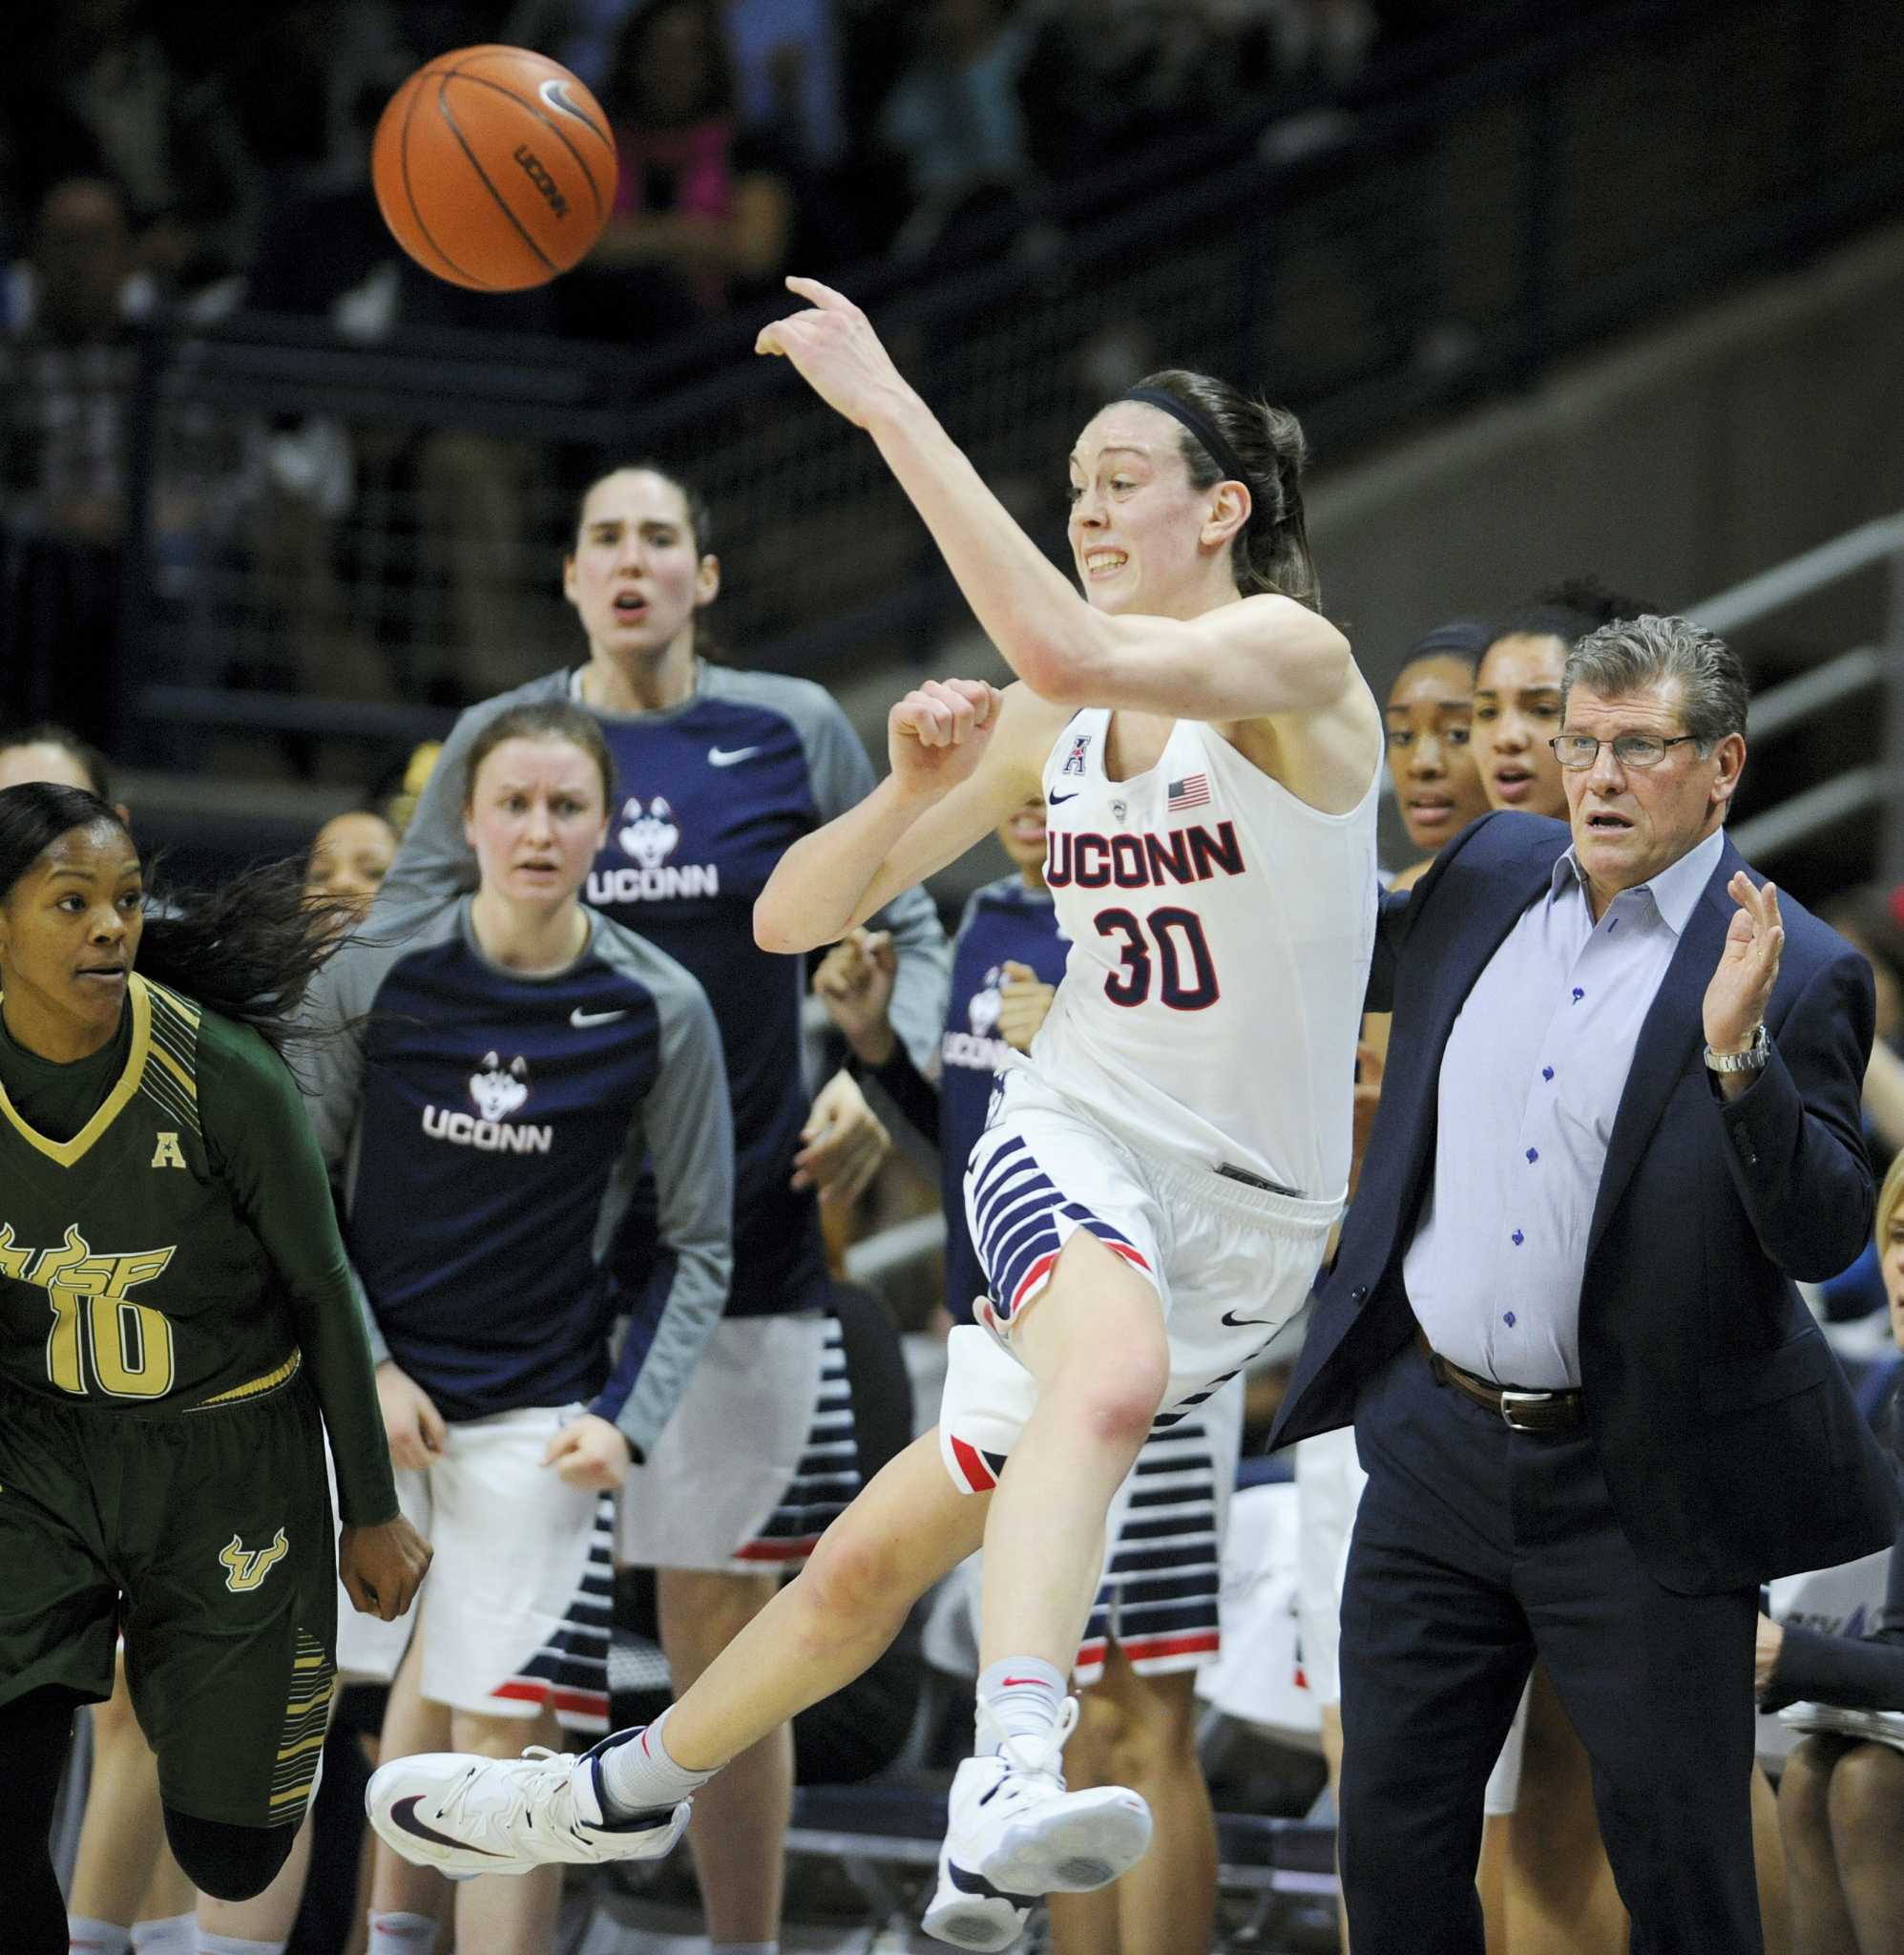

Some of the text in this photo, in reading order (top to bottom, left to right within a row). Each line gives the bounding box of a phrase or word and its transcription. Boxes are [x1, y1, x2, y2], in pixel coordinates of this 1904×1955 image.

[514, 144, 570, 219] UCONN
[586, 864, 720, 905] UCONN
[1047, 820, 1245, 889] UCONN
[1094, 907, 1220, 1011] 30
[151, 1132, 186, 1169] A
[422, 1104, 554, 1153] UCONN
[47, 1286, 175, 1399] 10
